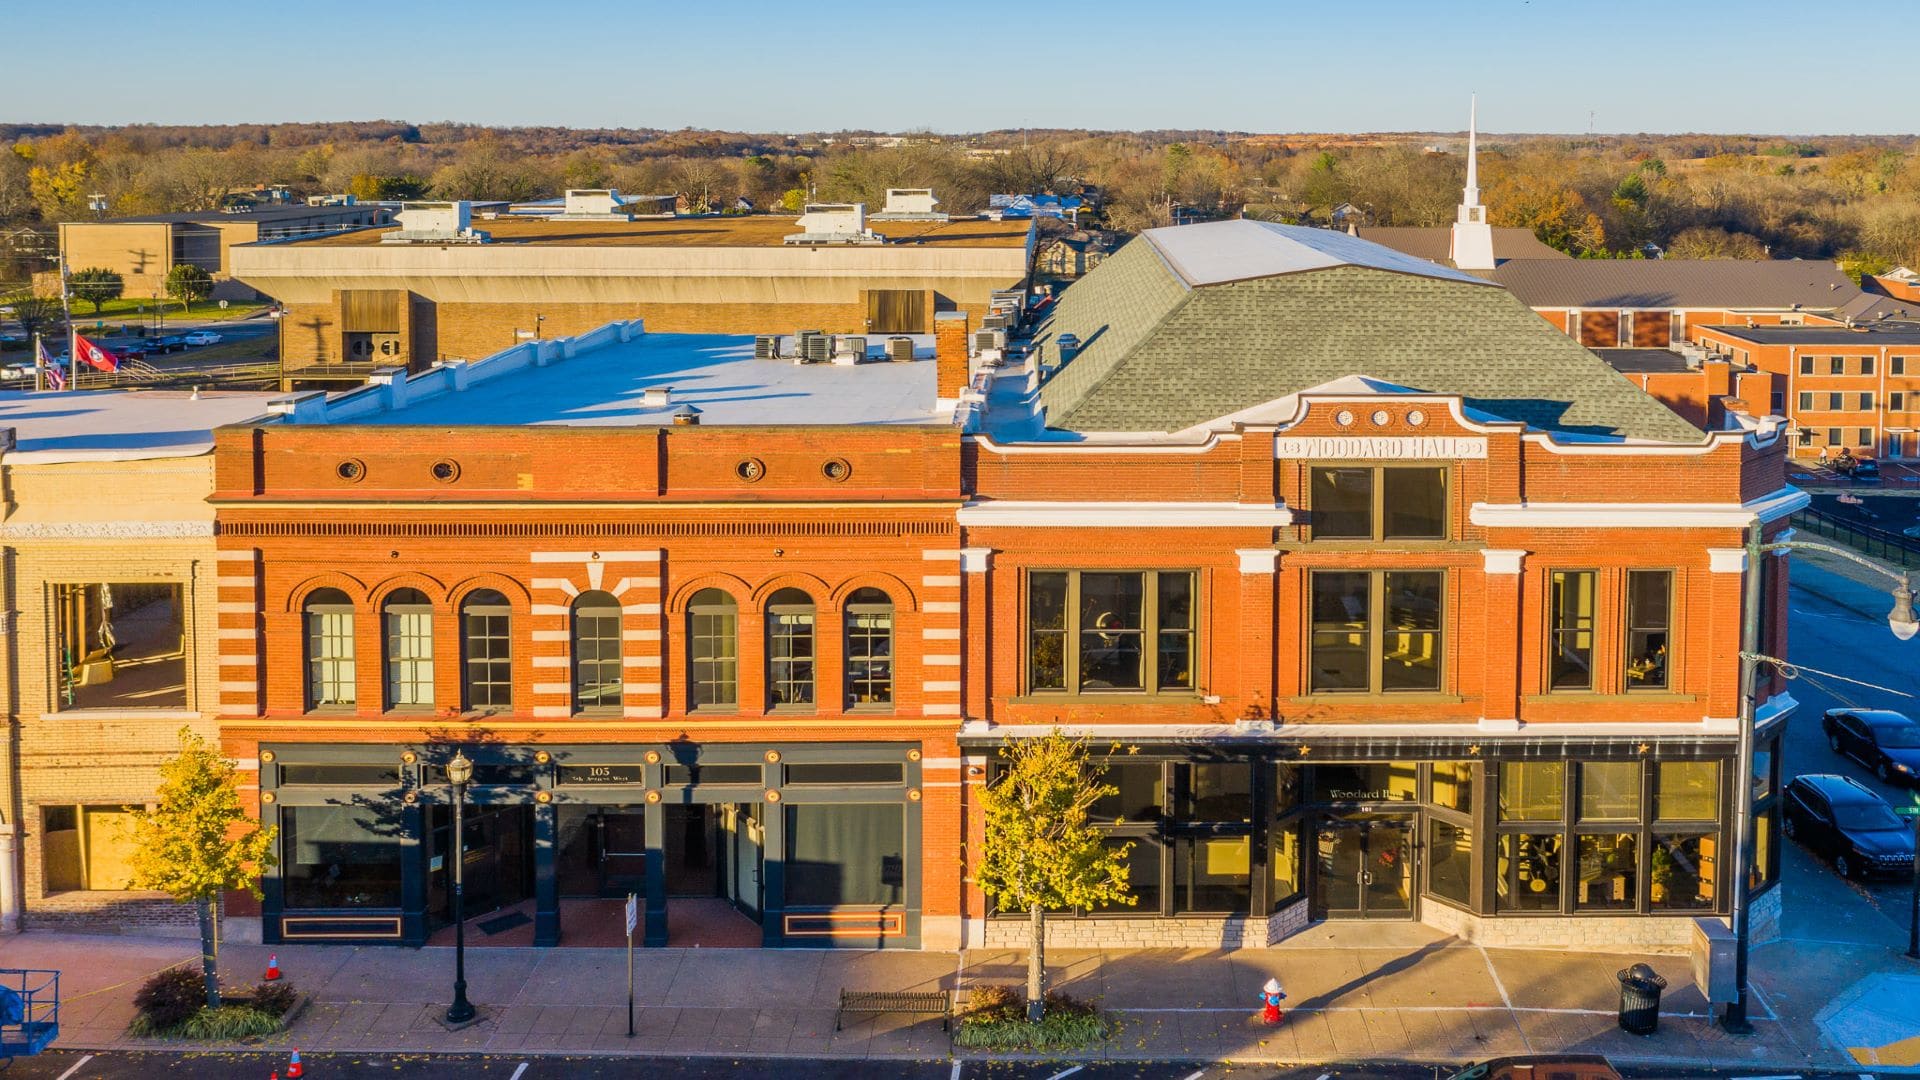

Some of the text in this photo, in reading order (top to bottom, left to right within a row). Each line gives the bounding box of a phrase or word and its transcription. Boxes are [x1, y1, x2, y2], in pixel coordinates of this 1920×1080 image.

[1304, 437, 1403, 457] WOODARD
[1411, 437, 1461, 457] HALL
[590, 767, 610, 776] 105
[1330, 788, 1379, 799] Woodard
